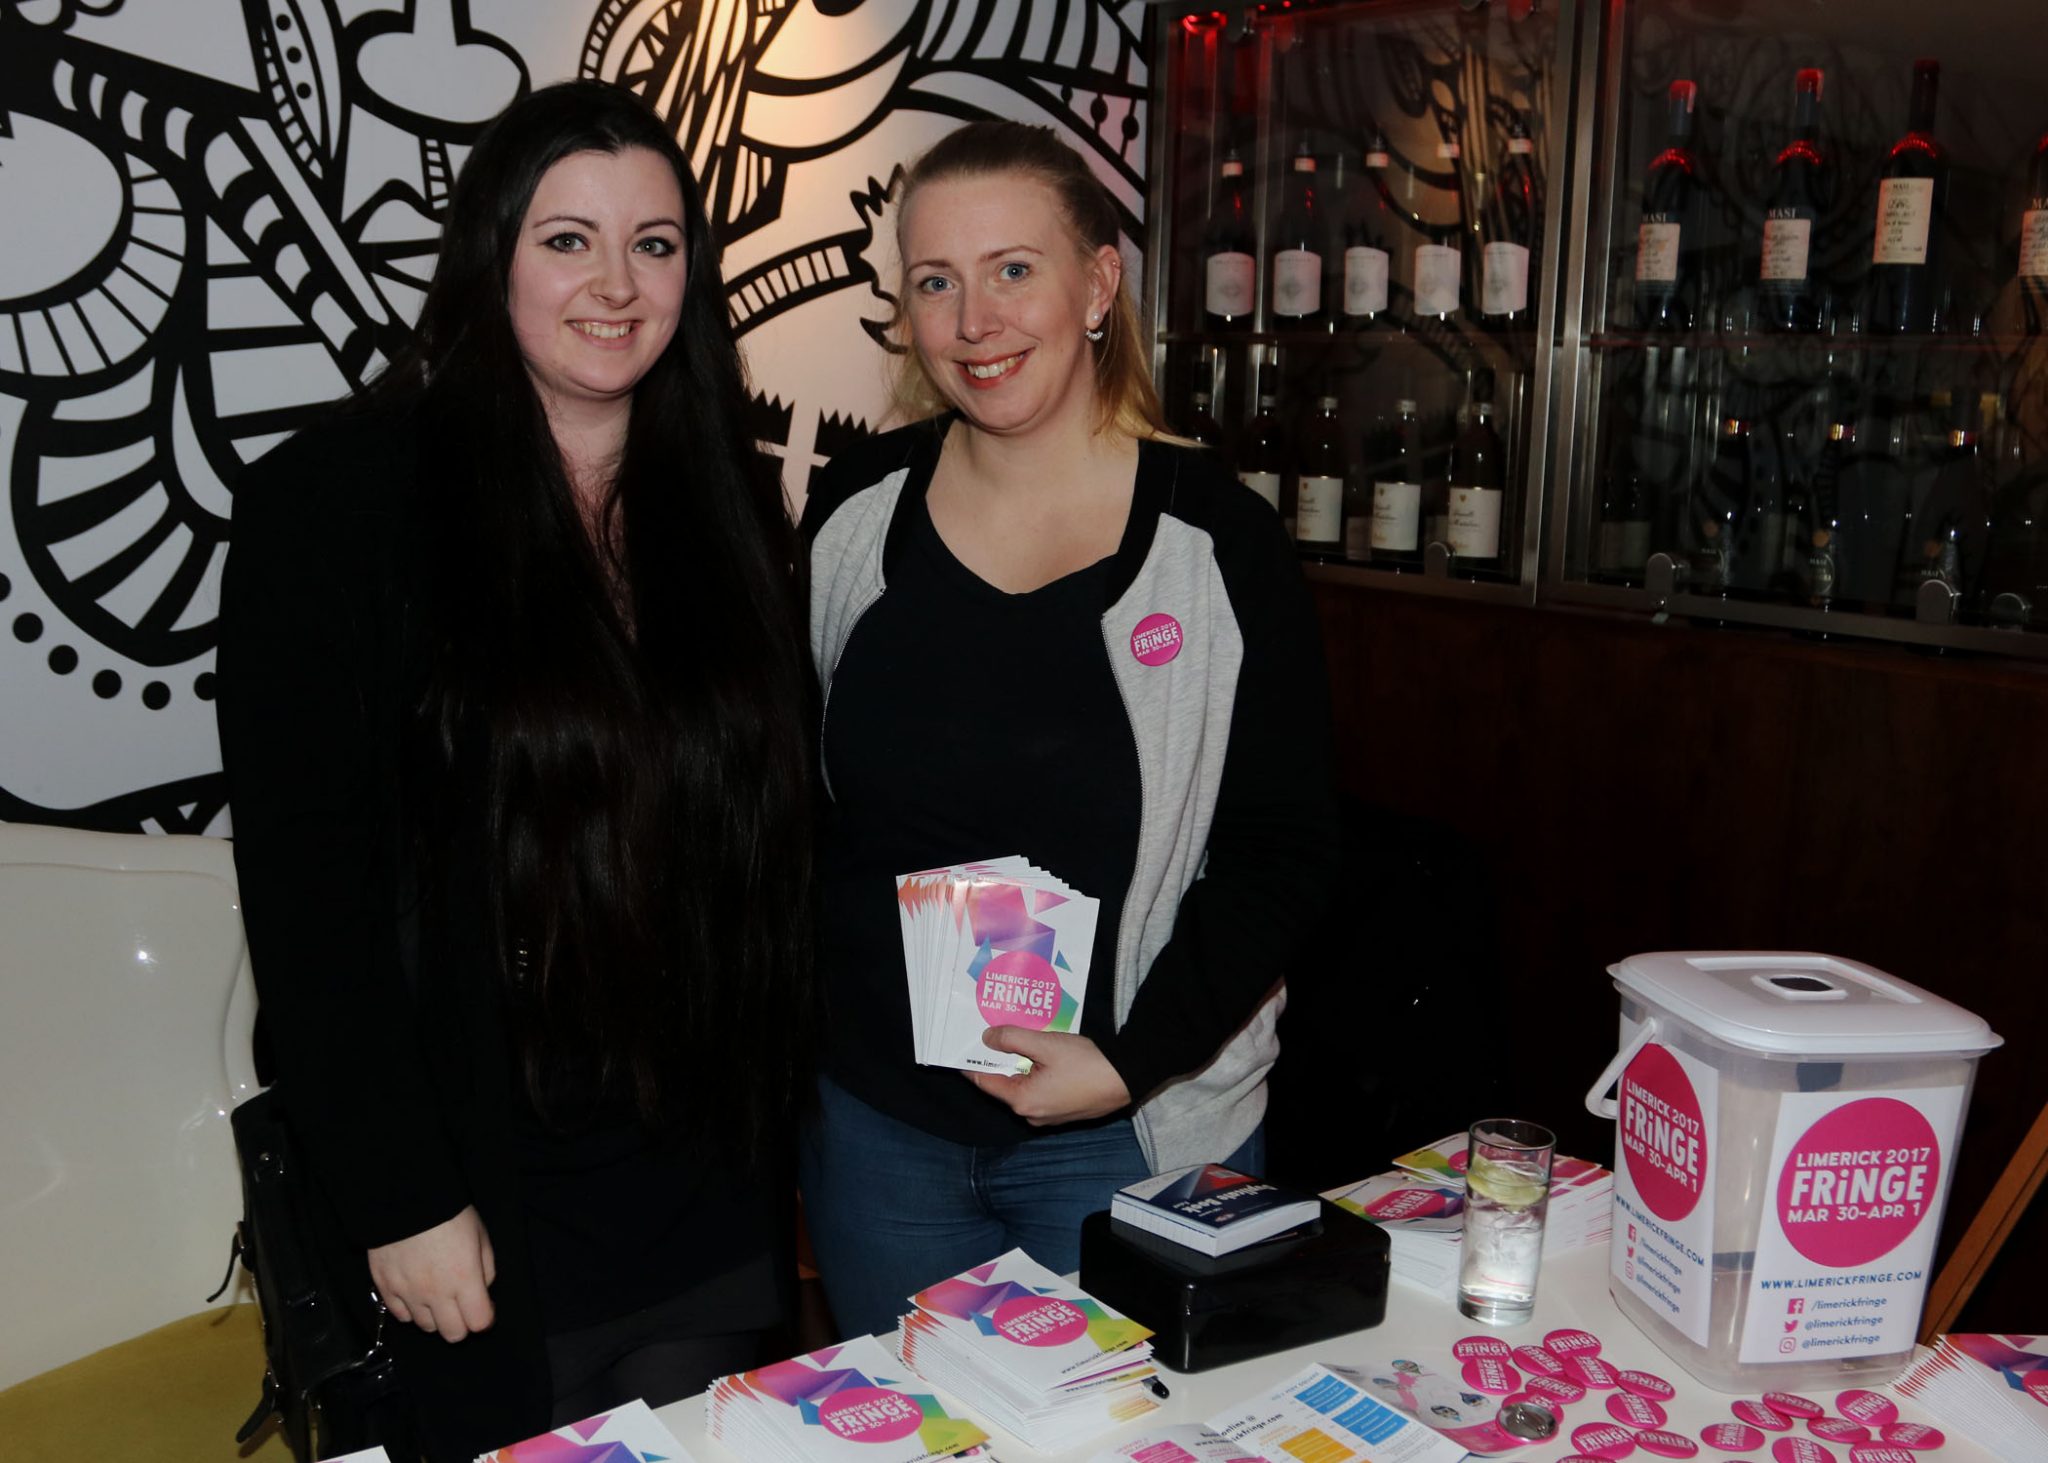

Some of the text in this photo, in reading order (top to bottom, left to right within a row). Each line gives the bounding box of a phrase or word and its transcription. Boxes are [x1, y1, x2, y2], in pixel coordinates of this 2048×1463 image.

[1768, 208, 1797, 219] MASI
[985, 972, 1056, 990] LIMERICK 2017
[981, 1001, 1002, 1010] MAR
[1025, 1008, 1044, 1017] APR
[1626, 1078, 1700, 1136] LIMERICK 2017
[1624, 1132, 1646, 1156] MAR
[1691, 1176, 1697, 1193] 1
[1796, 1147, 1931, 1167] LIMERICK 2017
[1787, 1202, 1920, 1223] MAR 30-APR 1
[1760, 1270, 1922, 1289] WWW.LIMERICKFRINGE.COM
[1811, 1296, 1887, 1312] /limerickfringe
[999, 1301, 1062, 1330] LIMERICK 2017
[1804, 1315, 1884, 1331] @limerickfringe
[1020, 1332, 1040, 1344] MAR
[1059, 1317, 1078, 1327] APR
[1801, 1334, 1880, 1350] @limerickfringe
[824, 1394, 900, 1420] LIMERICK 2017
[843, 1425, 866, 1437] MAR
[890, 1413, 910, 1423] APR
